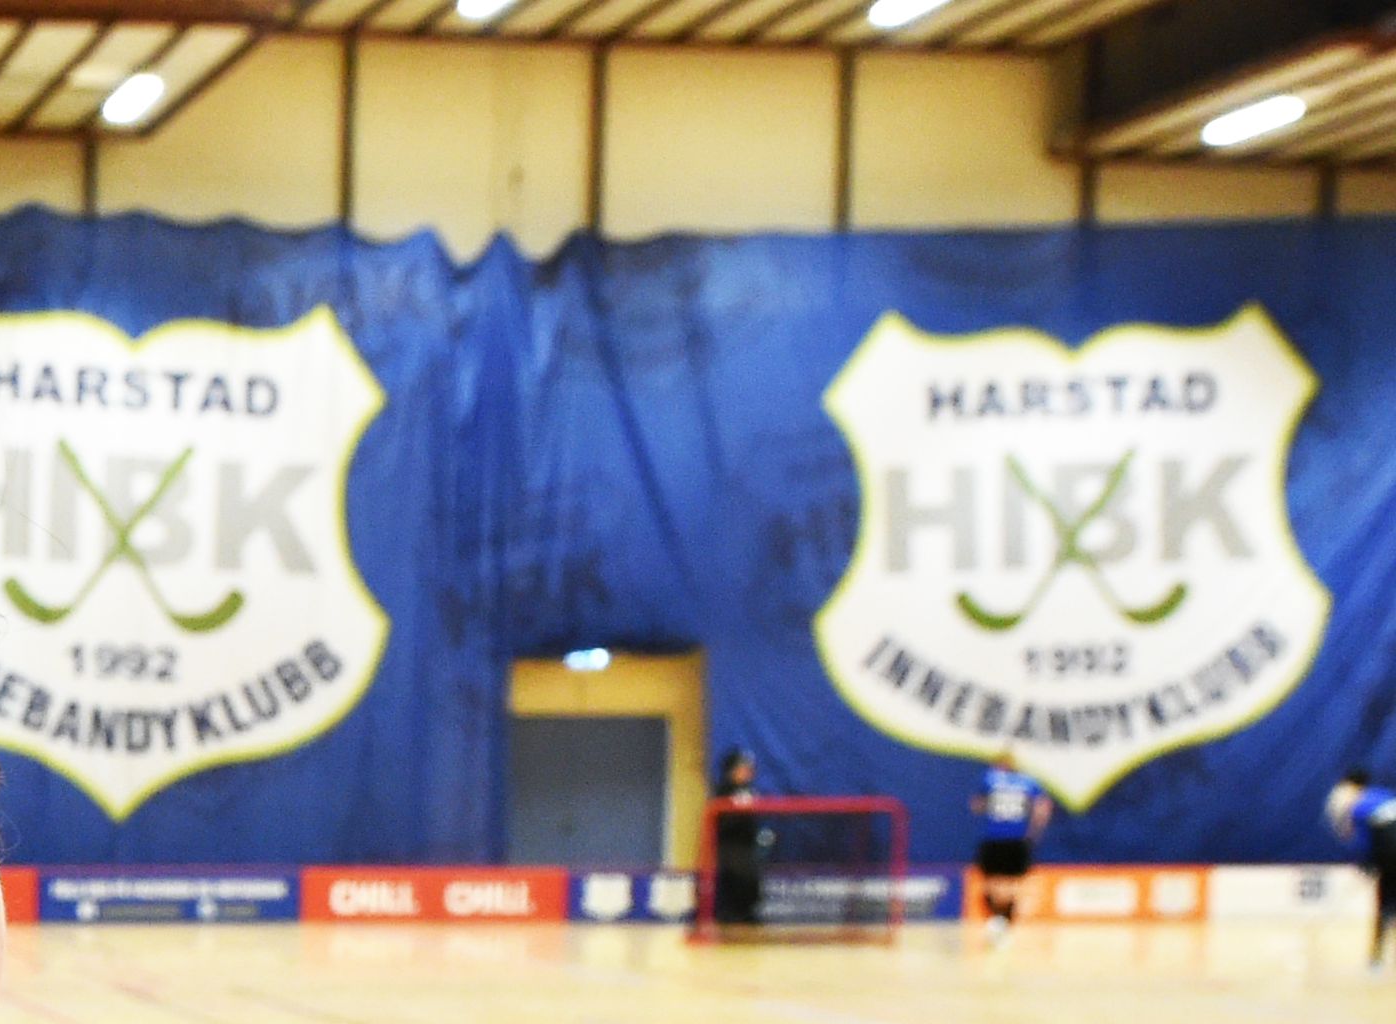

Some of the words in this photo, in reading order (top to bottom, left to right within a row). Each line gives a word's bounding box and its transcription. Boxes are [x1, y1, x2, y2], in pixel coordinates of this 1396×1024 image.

[926, 370, 1221, 424] HARSTAD
[69, 642, 178, 682] 1992
[862, 624, 1286, 746] INNEBANDYKLUBB
